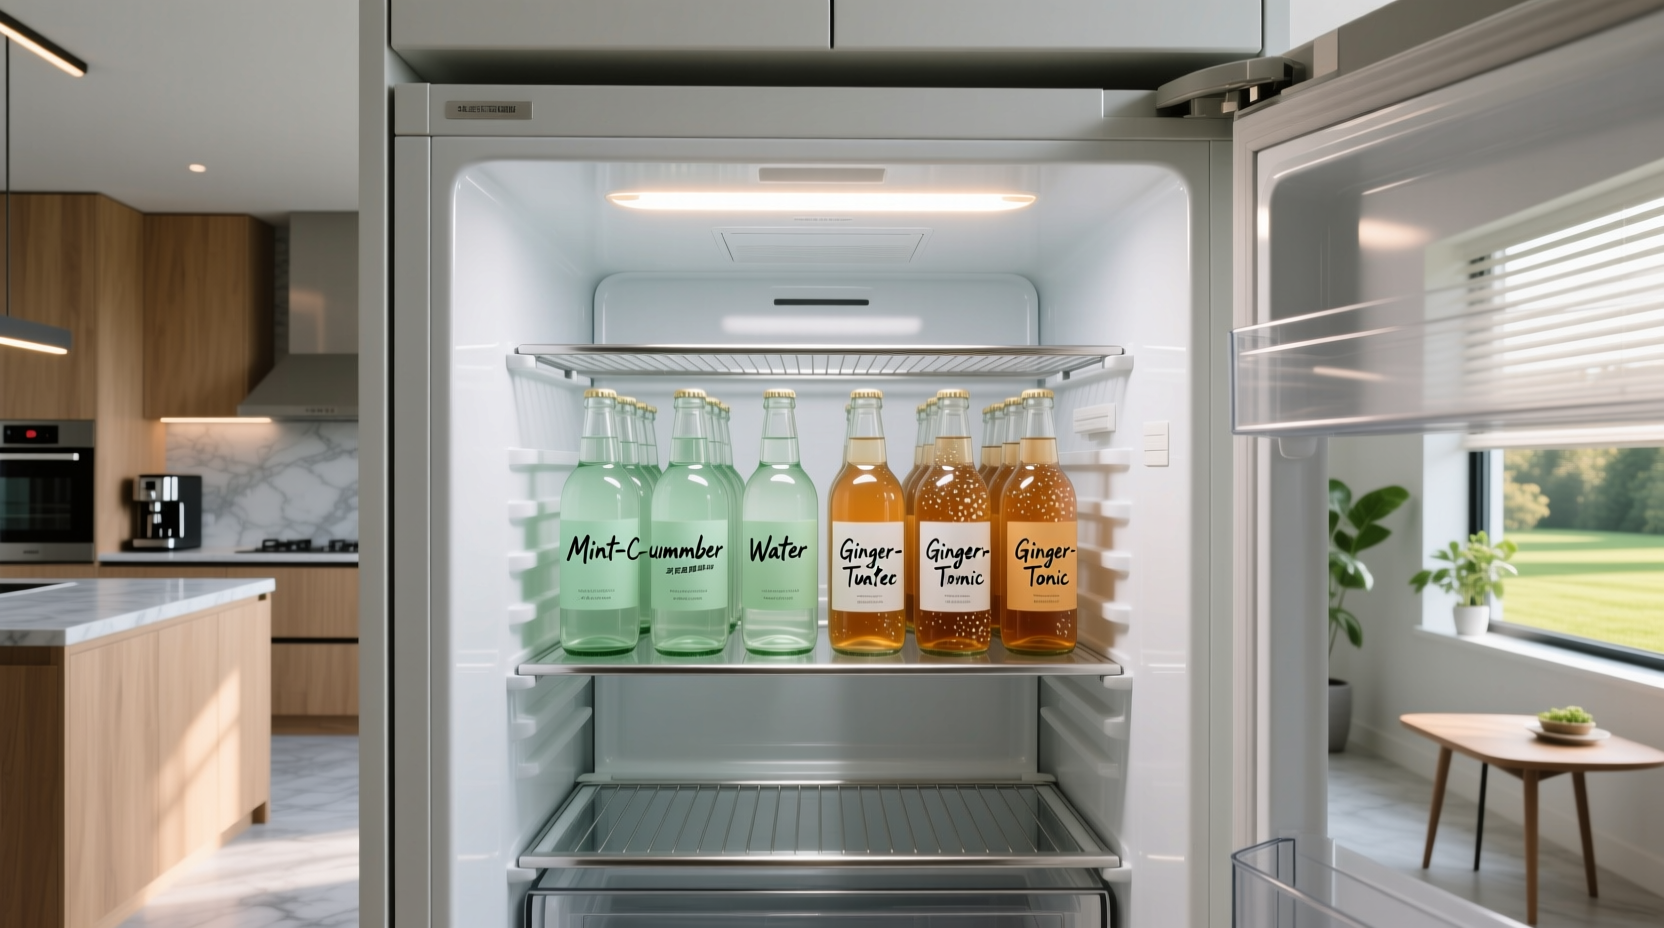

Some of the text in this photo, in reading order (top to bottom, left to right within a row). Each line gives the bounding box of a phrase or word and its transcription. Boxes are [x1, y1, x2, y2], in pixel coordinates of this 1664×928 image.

[750, 534, 808, 562] Water
[840, 537, 902, 569] Ginger-
[1014, 537, 1076, 569] Ginger-
[1023, 565, 1070, 588] Tonic
